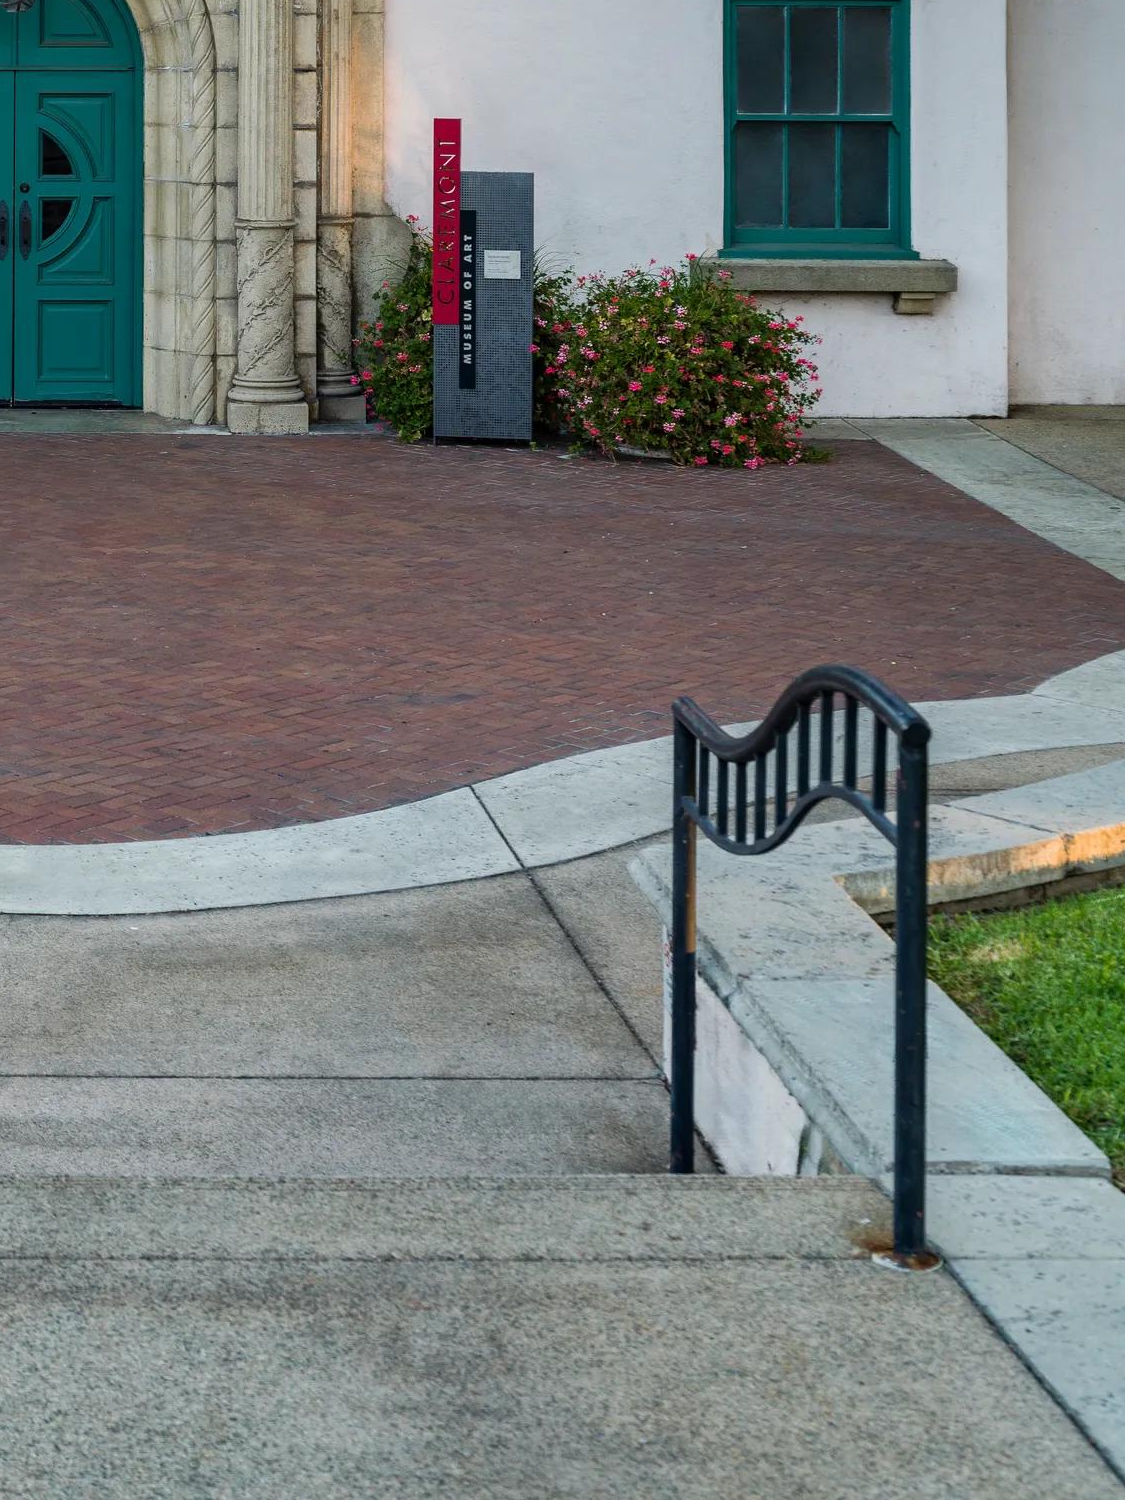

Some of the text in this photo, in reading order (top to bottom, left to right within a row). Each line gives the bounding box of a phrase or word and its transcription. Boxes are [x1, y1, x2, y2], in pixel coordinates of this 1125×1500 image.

[437, 139, 456, 306] CLAREMONT
[463, 234, 473, 365] MUSEUM OF ART
